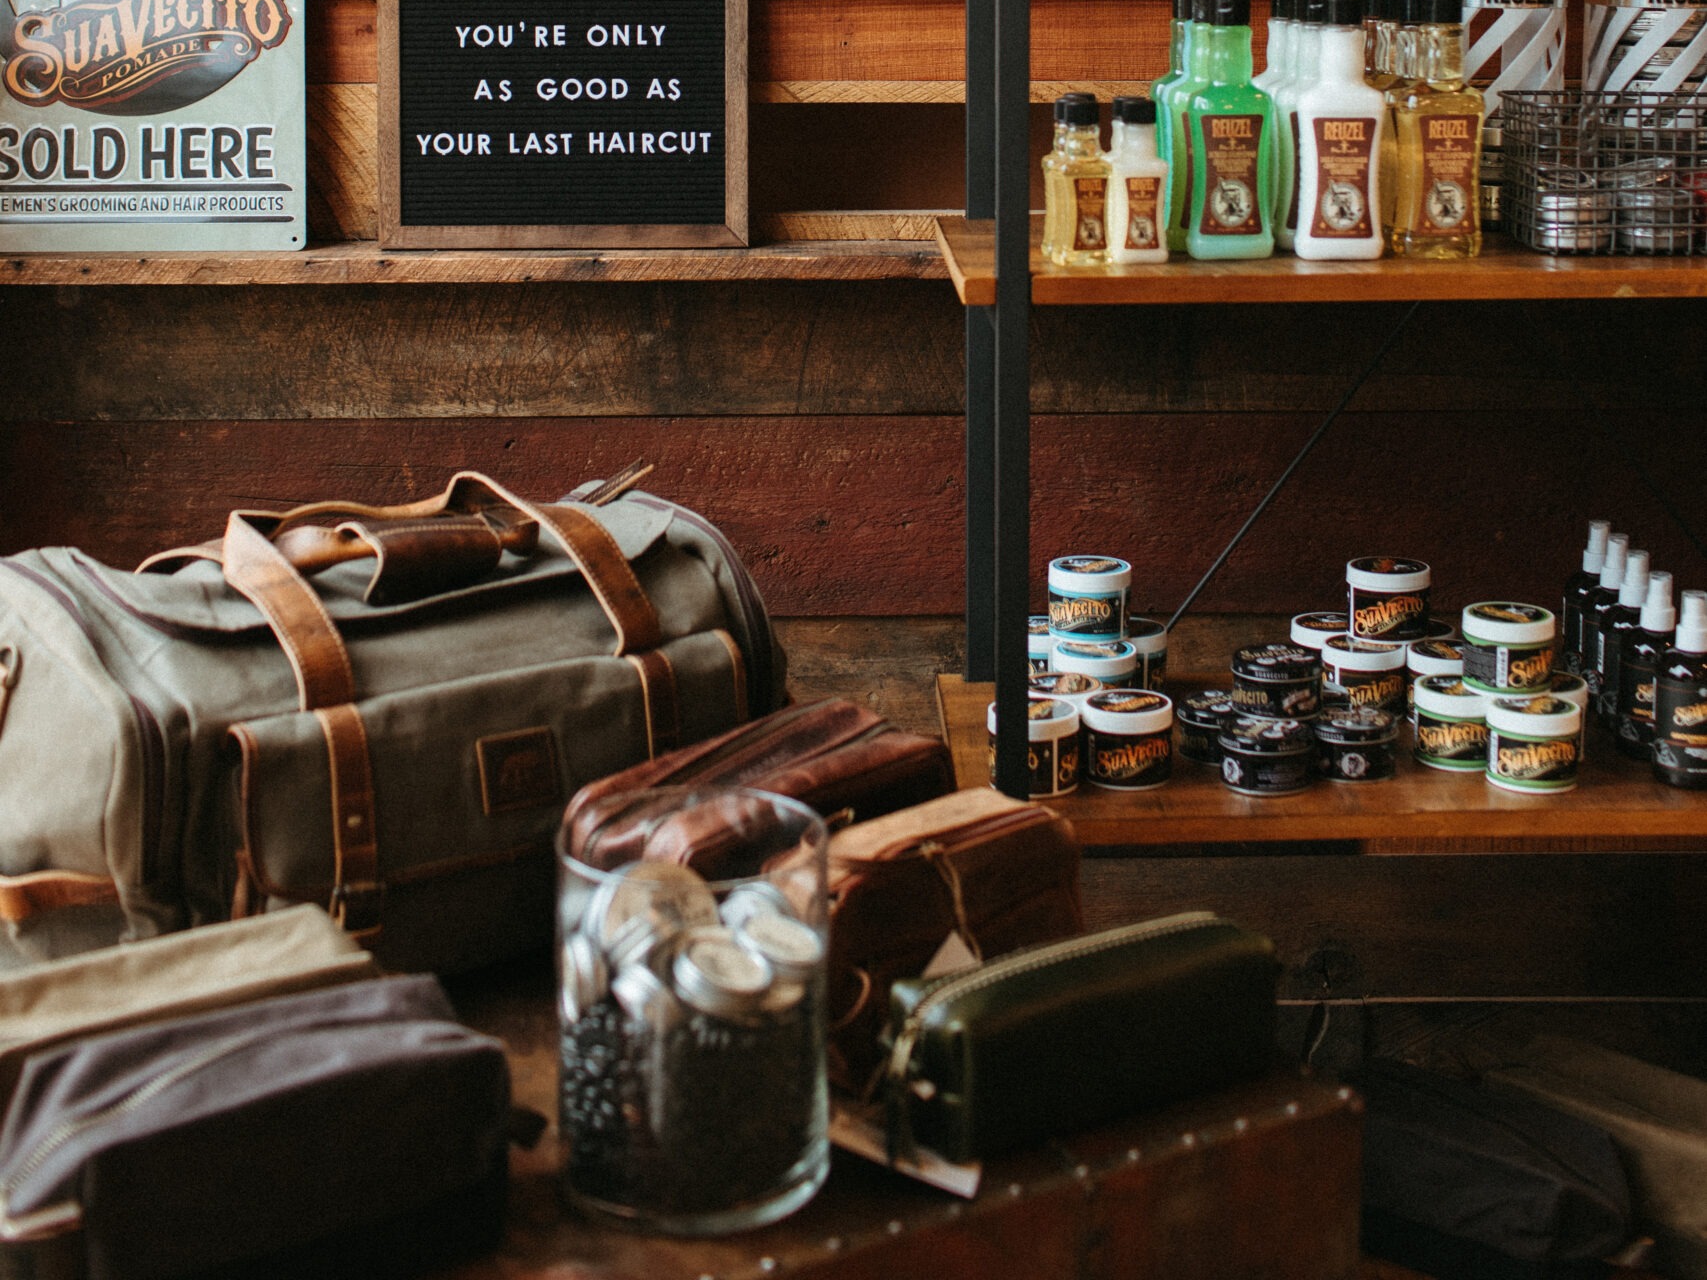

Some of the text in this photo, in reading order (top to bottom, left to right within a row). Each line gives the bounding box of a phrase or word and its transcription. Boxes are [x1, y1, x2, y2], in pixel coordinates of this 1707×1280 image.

[455, 21, 666, 48] YOU'RE ONLY
[101, 38, 201, 90] POMADE
[474, 78, 682, 102] AS GOOD AS
[1212, 118, 1253, 138] REUZEL
[1324, 121, 1366, 141] REUZEL
[1429, 119, 1469, 139] REUZEL
[0, 127, 274, 180] SOLD HERE
[416, 131, 712, 156] YOUR LAST HAIRCUT
[12, 197, 57, 212] MEN'S
[60, 197, 137, 212] GROOMING
[140, 197, 169, 211] AND
[173, 197, 206, 211] HAIR
[209, 196, 284, 211] PRODUCTS
